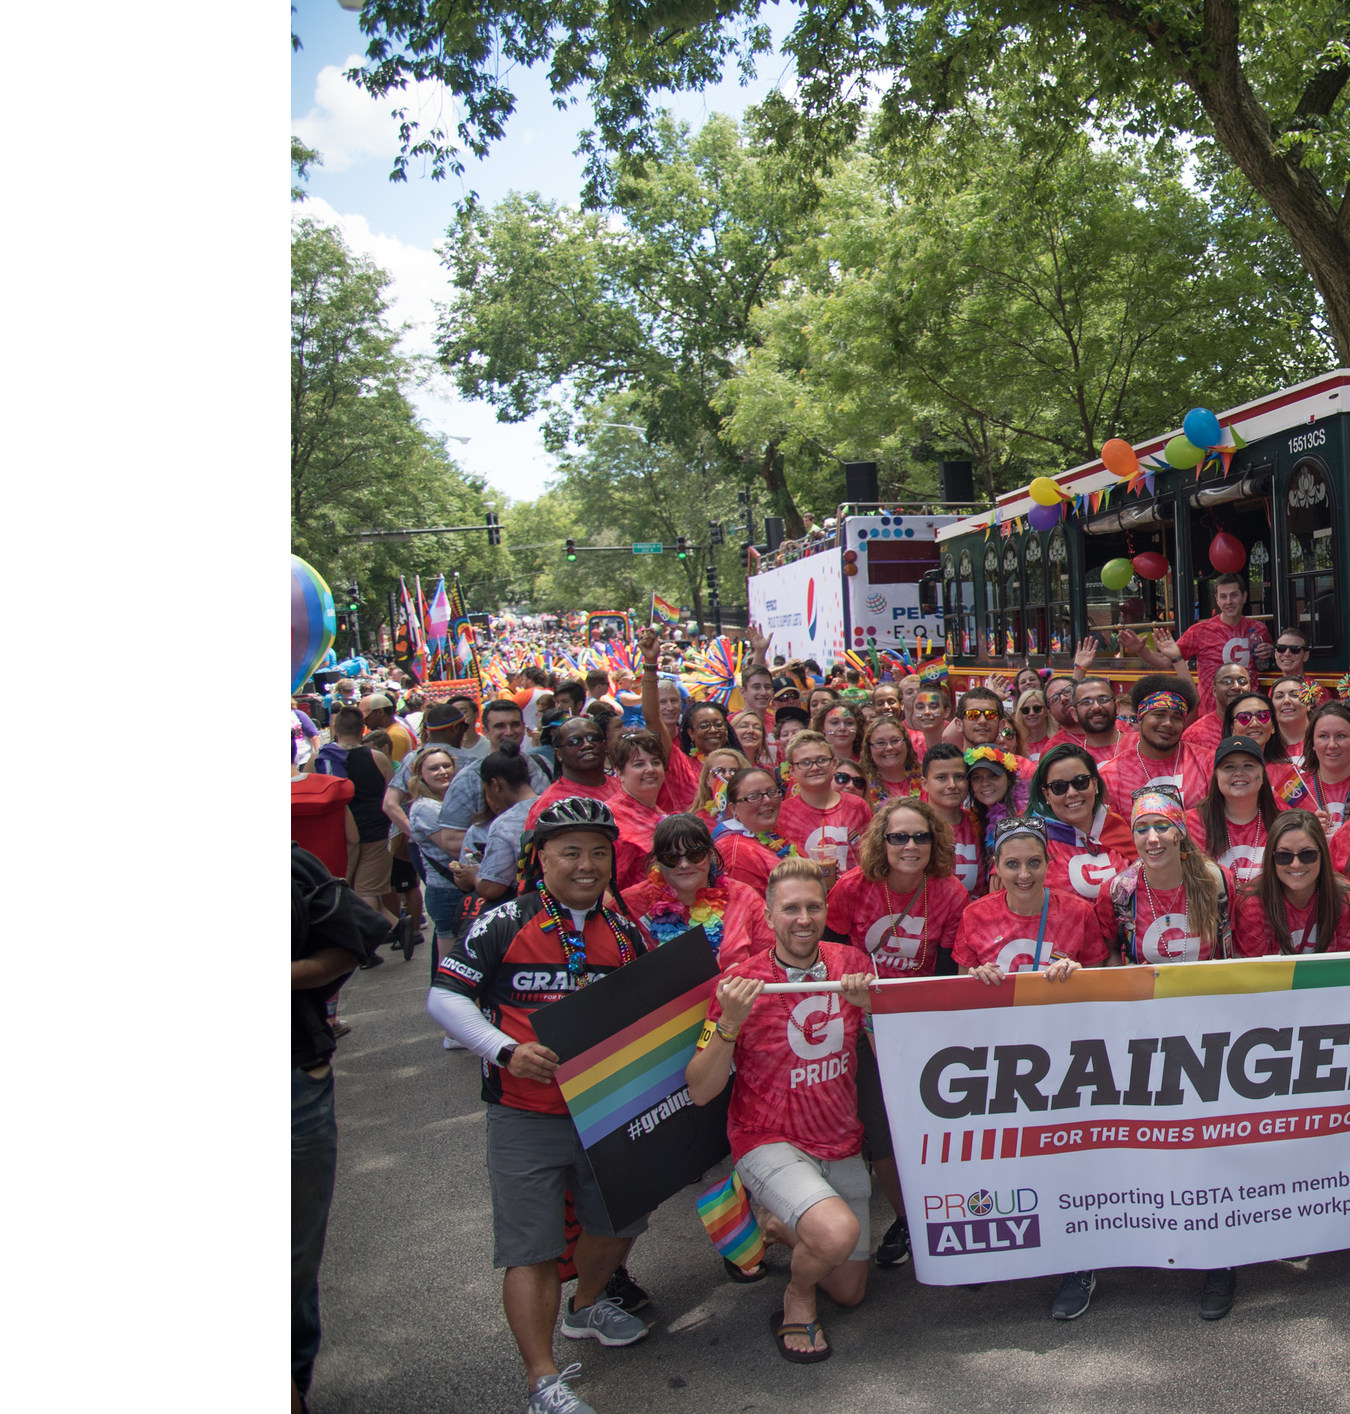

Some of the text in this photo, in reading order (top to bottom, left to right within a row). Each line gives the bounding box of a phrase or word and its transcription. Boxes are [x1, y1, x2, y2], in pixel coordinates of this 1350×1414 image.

[1288, 428, 1326, 454] 15513CS
[1222, 637, 1250, 668] G
[1068, 853, 1117, 898] G
[865, 913, 926, 958] G
[1142, 913, 1200, 963] G
[787, 993, 845, 1060] G
[791, 1051, 850, 1089] PRIDE
[1039, 1128, 1083, 1149] FOR
[1089, 1126, 1130, 1142] THE
[1136, 1127, 1195, 1143] ONES
[1201, 1121, 1252, 1141] WHO
[1258, 1117, 1299, 1136] GET
[1303, 1114, 1323, 1131] IT
[924, 1188, 1039, 1220] PROUD
[1058, 1187, 1165, 1215] Supporting
[1170, 1187, 1234, 1207] LGBTA
[1238, 1180, 1287, 1200] team
[936, 1218, 1033, 1254] ALLY
[1064, 1217, 1089, 1235] an
[1094, 1212, 1178, 1233] inclusive
[1183, 1213, 1220, 1232] and
[1224, 1206, 1293, 1230] diverse
